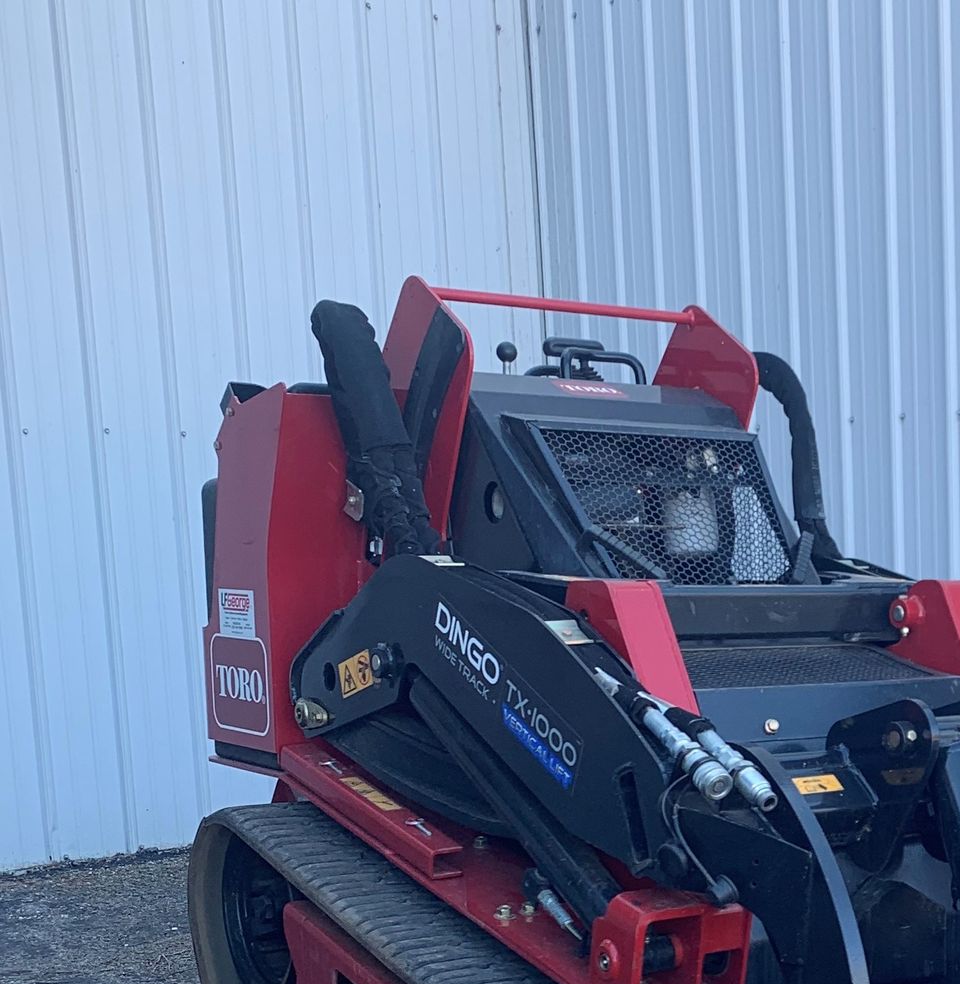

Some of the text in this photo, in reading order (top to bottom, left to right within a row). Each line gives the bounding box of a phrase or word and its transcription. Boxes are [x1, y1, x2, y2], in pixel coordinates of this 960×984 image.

[434, 635, 490, 701] WIDE TRACK
[435, 602, 500, 685] DINGO
[215, 664, 263, 703] TORO
[503, 708, 571, 785] VERTICAL LIFT
